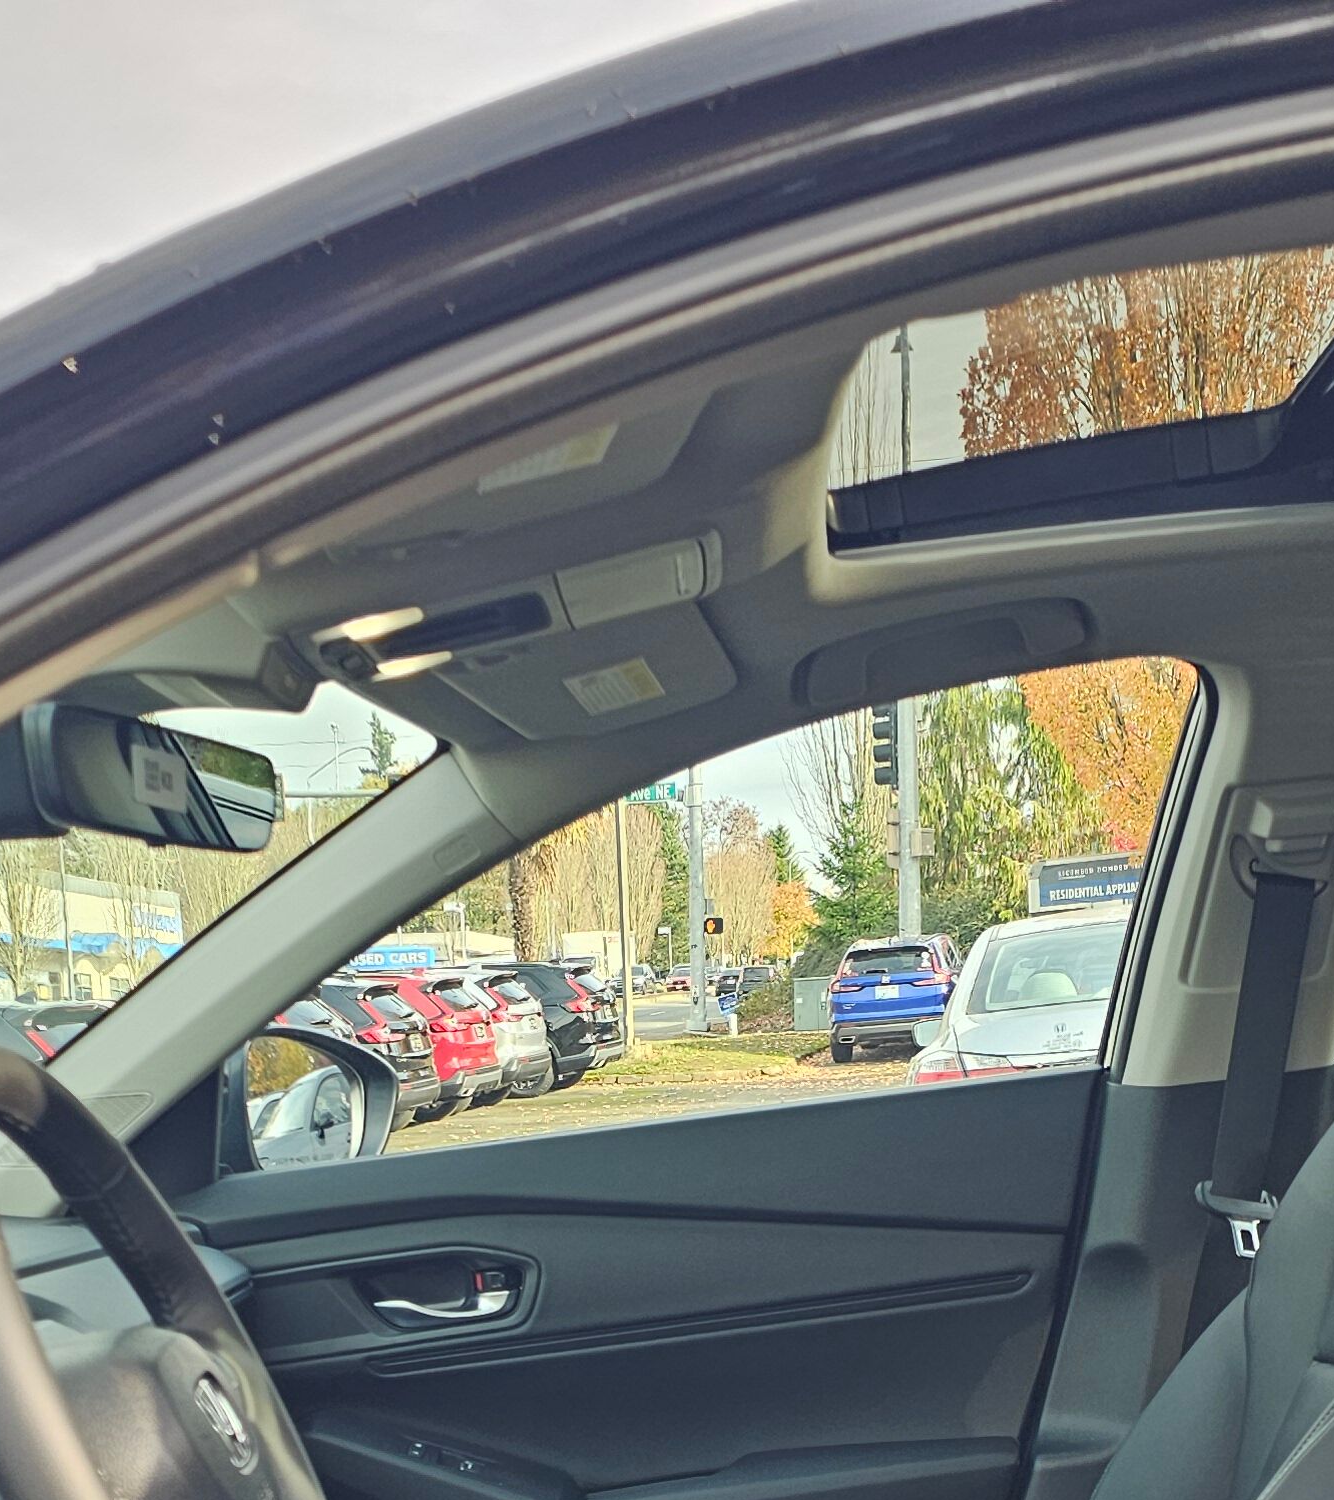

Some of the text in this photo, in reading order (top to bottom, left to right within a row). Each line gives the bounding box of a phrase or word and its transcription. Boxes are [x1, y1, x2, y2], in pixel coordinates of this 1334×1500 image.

[630, 784, 672, 801] Ave NE
[1049, 886, 1104, 902] RESIDENTIAL
[388, 951, 428, 965] CARS
